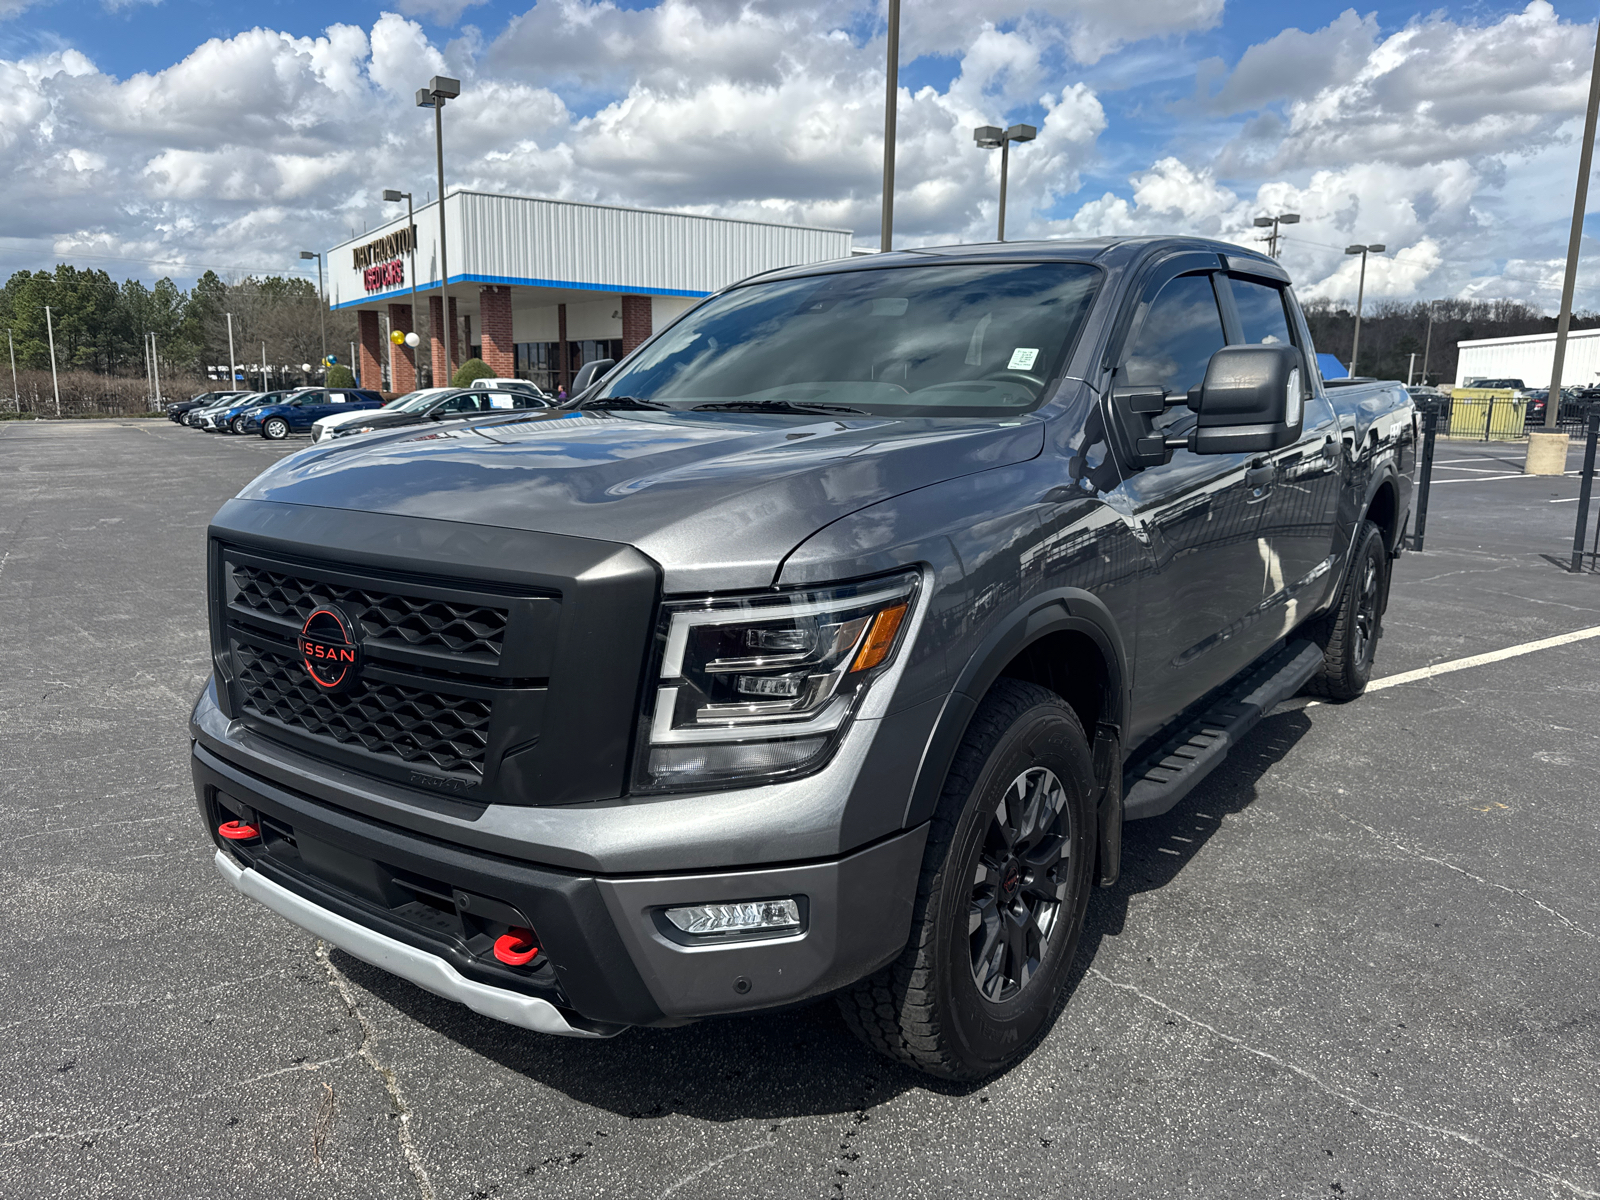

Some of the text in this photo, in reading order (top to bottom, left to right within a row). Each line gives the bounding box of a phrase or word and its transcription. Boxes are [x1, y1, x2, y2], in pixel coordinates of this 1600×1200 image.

[353, 243, 372, 270] JOHN
[363, 259, 403, 291] USED CARS
